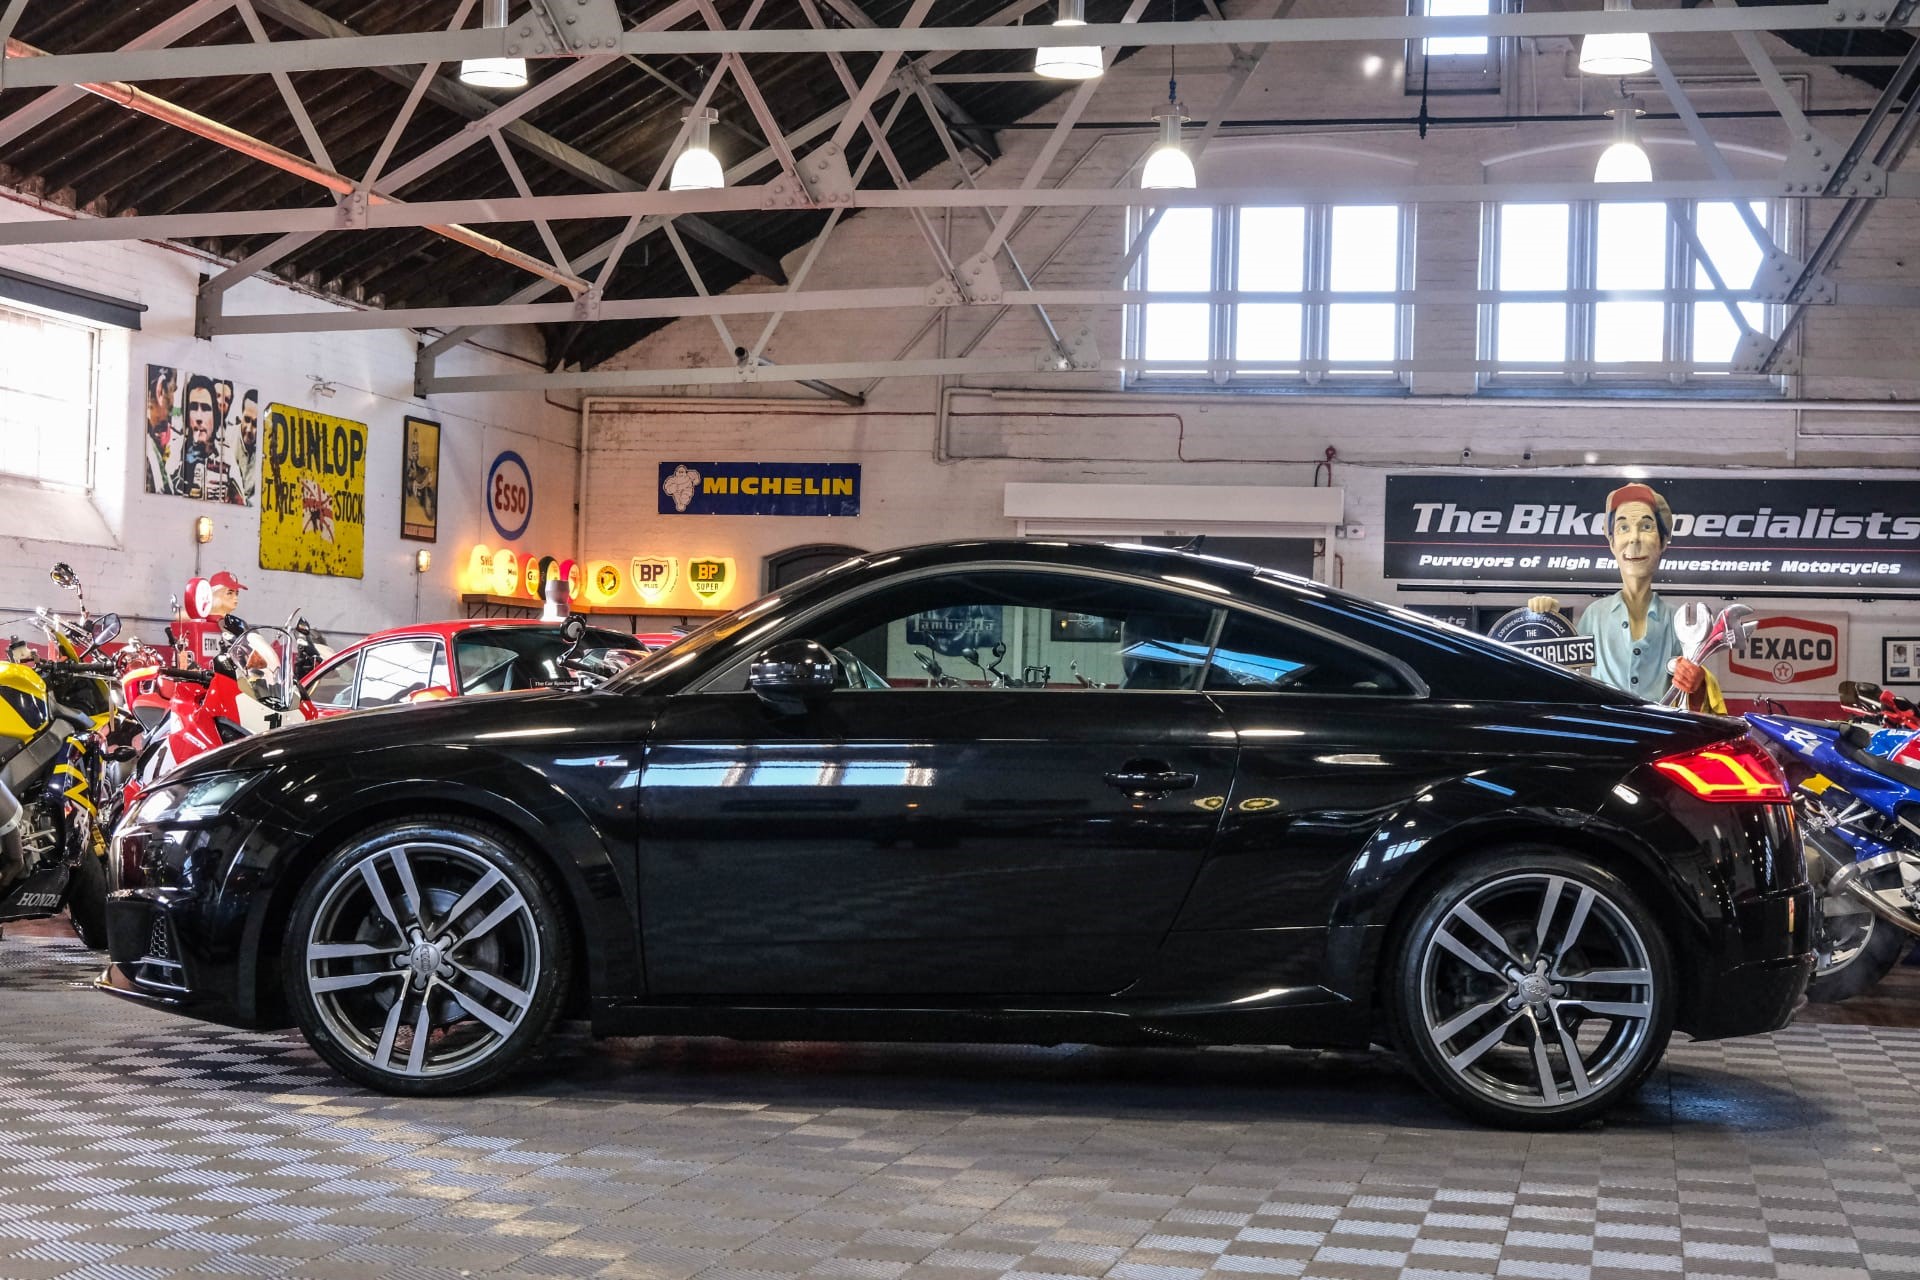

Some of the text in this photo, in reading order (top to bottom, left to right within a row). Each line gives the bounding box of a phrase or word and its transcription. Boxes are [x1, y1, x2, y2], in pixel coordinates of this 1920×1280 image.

[271, 412, 363, 481] DUNLOP
[703, 477, 853, 495] MICHELIN
[334, 490, 364, 524] STOCK
[1413, 503, 1503, 533] The
[1671, 507, 1920, 540] pecialists
[697, 564, 719, 580] BP
[1419, 555, 1901, 575] Purveyors of High En Investment Motorcycles
[696, 582, 719, 591] SUPER
[1525, 629, 1537, 637] THE
[1522, 642, 1595, 663] CIALISTS
[16, 892, 62, 908] HONDA
